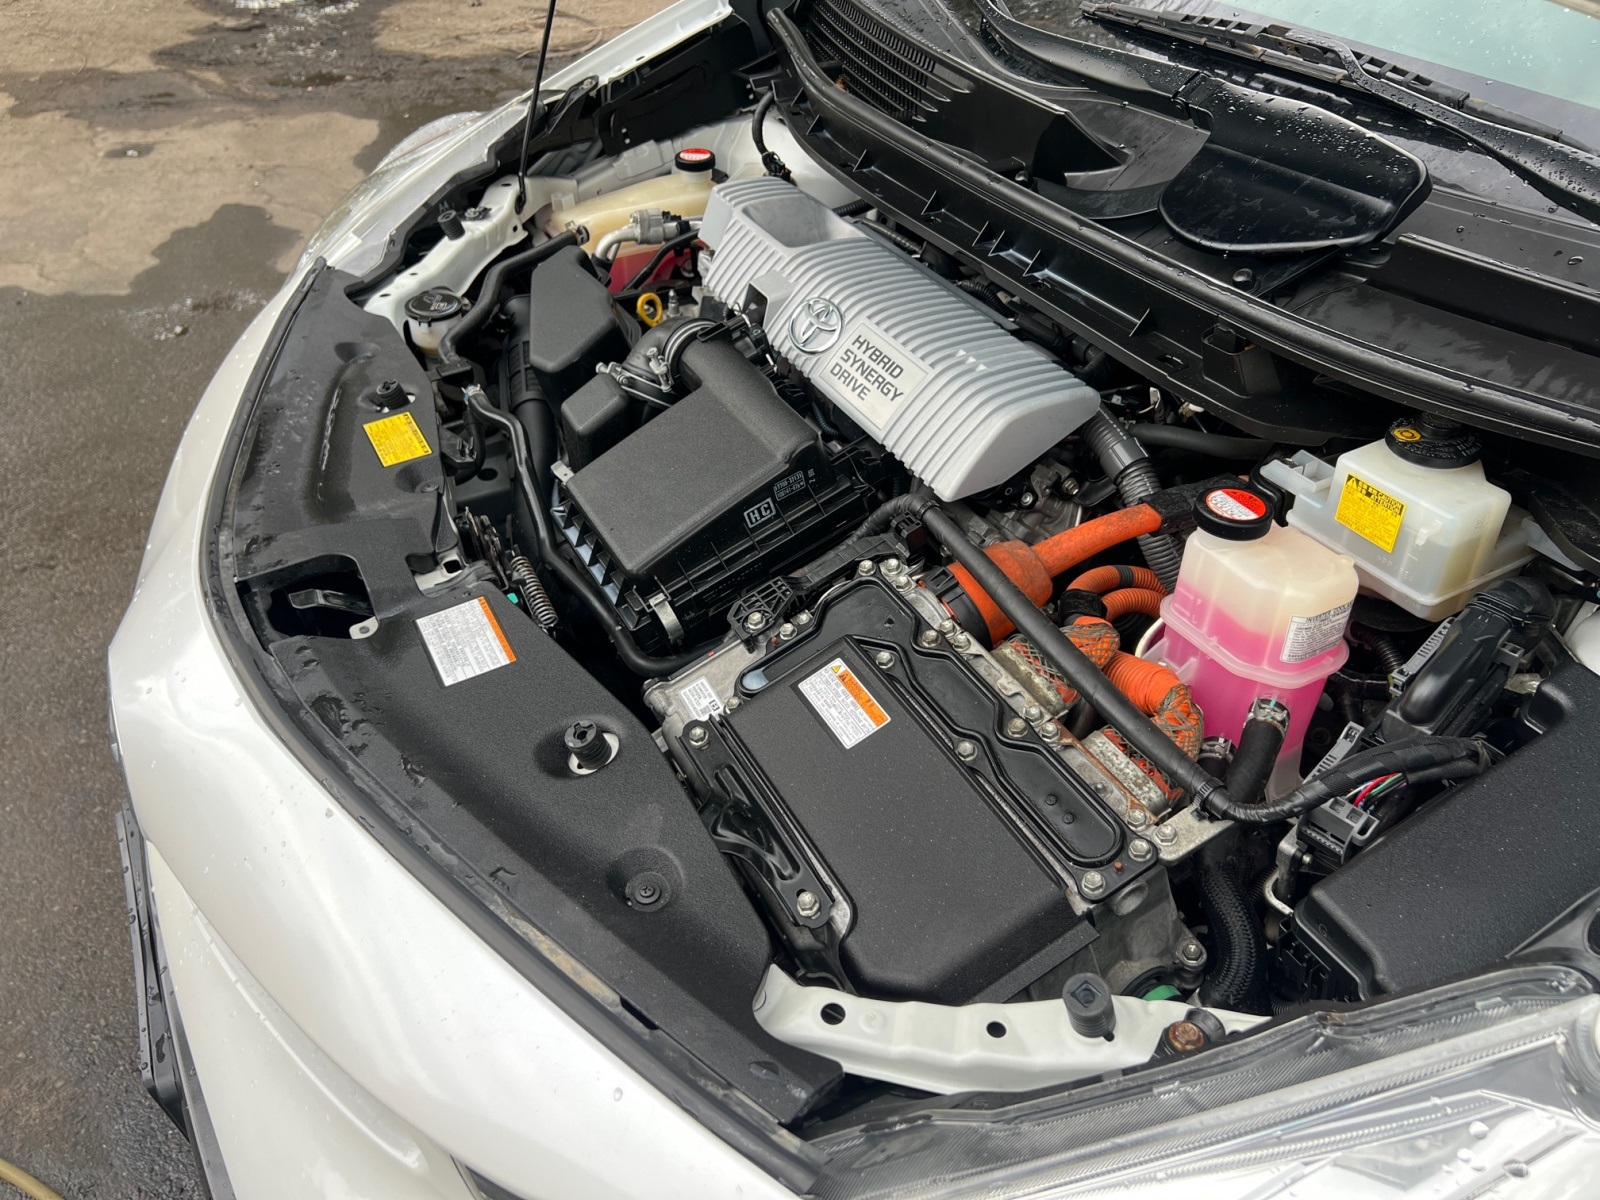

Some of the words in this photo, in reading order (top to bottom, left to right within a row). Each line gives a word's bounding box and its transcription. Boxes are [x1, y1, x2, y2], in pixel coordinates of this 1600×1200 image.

[852, 334, 904, 379] HYBRID
[829, 361, 871, 401] DRIVE
[840, 349, 905, 402] SYNERGY
[749, 503, 771, 523] HC
[1370, 494, 1401, 516] ATTENTION
[1377, 490, 1402, 509] CAUTION
